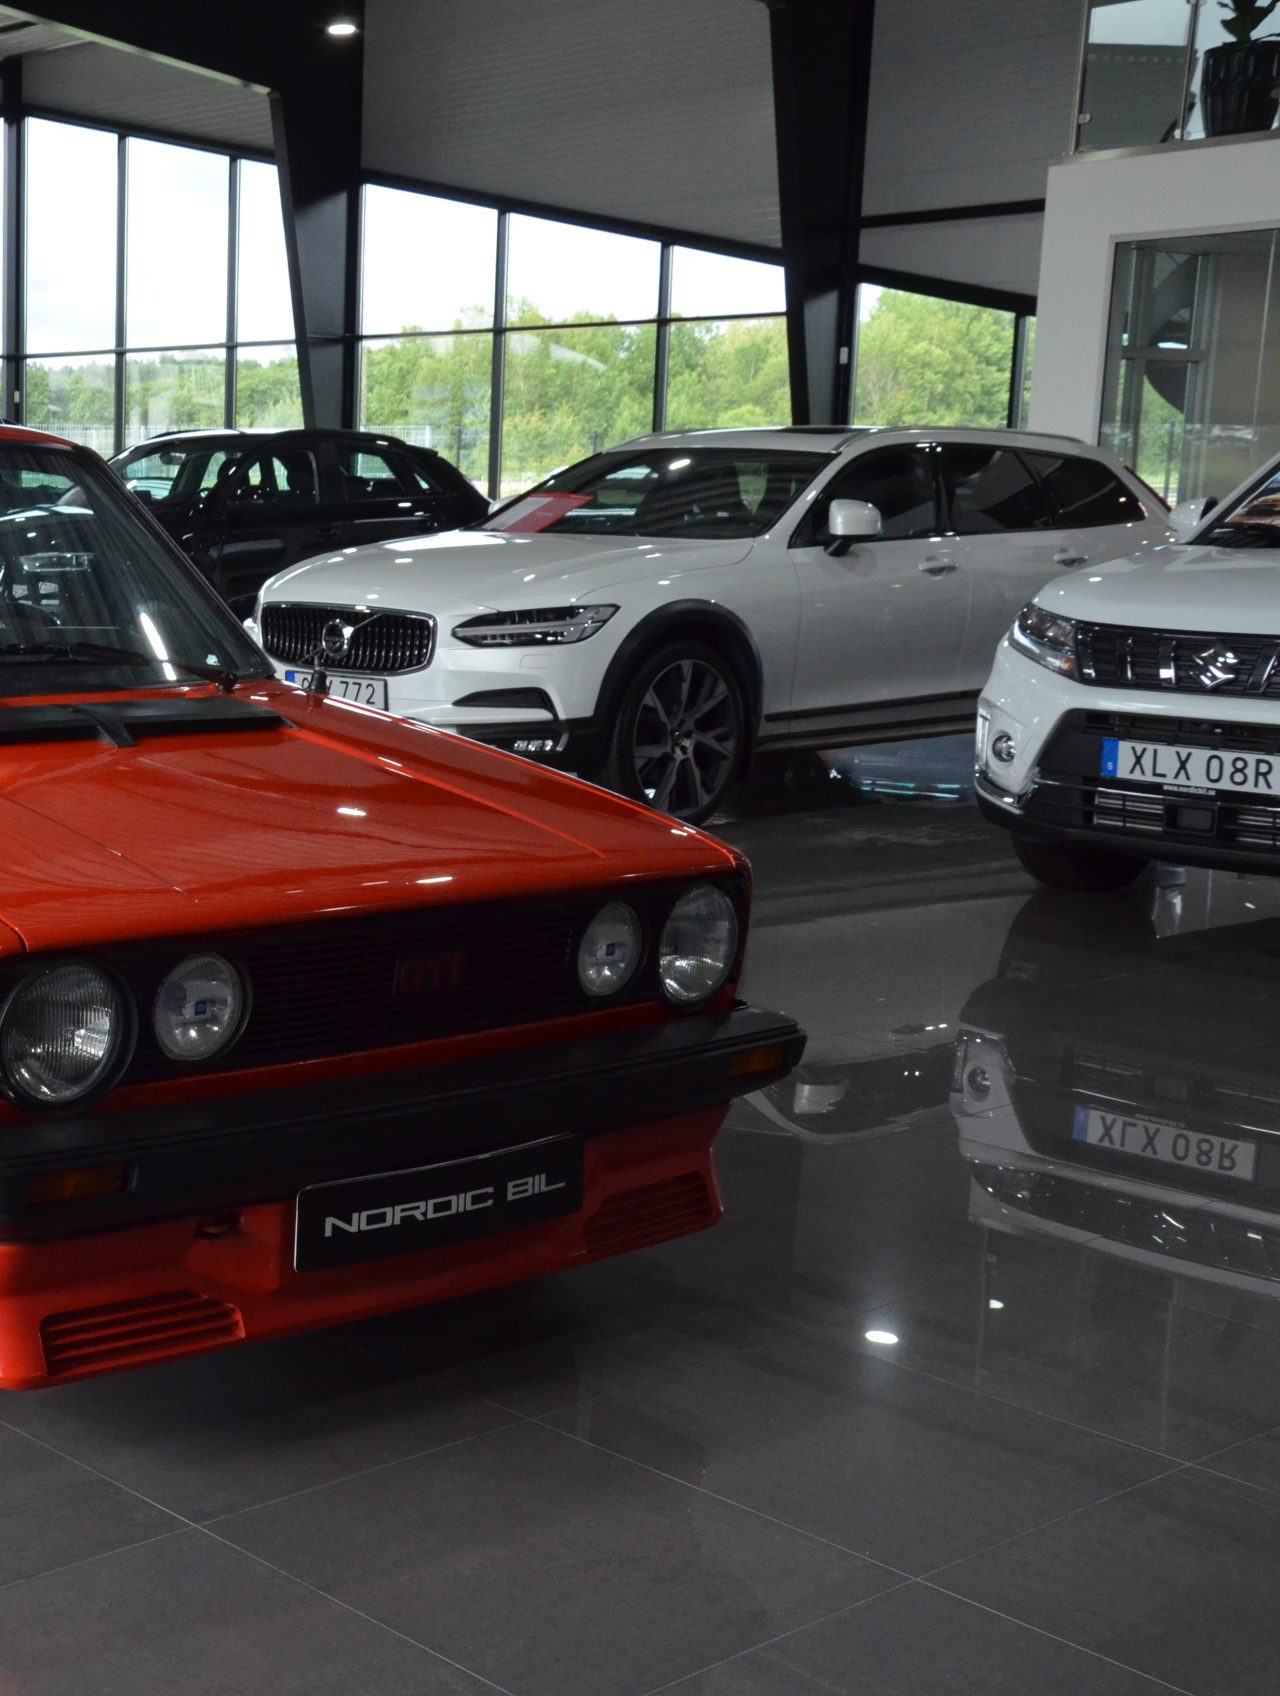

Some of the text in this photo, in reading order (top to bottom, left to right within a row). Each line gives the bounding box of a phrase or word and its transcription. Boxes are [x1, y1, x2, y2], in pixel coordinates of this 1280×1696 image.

[340, 680, 376, 705] 772
[1106, 761, 1114, 771] S
[1129, 745, 1273, 790] XLX 08R
[399, 954, 461, 994] GTI
[324, 1173, 566, 1238] NORDIC BIL
